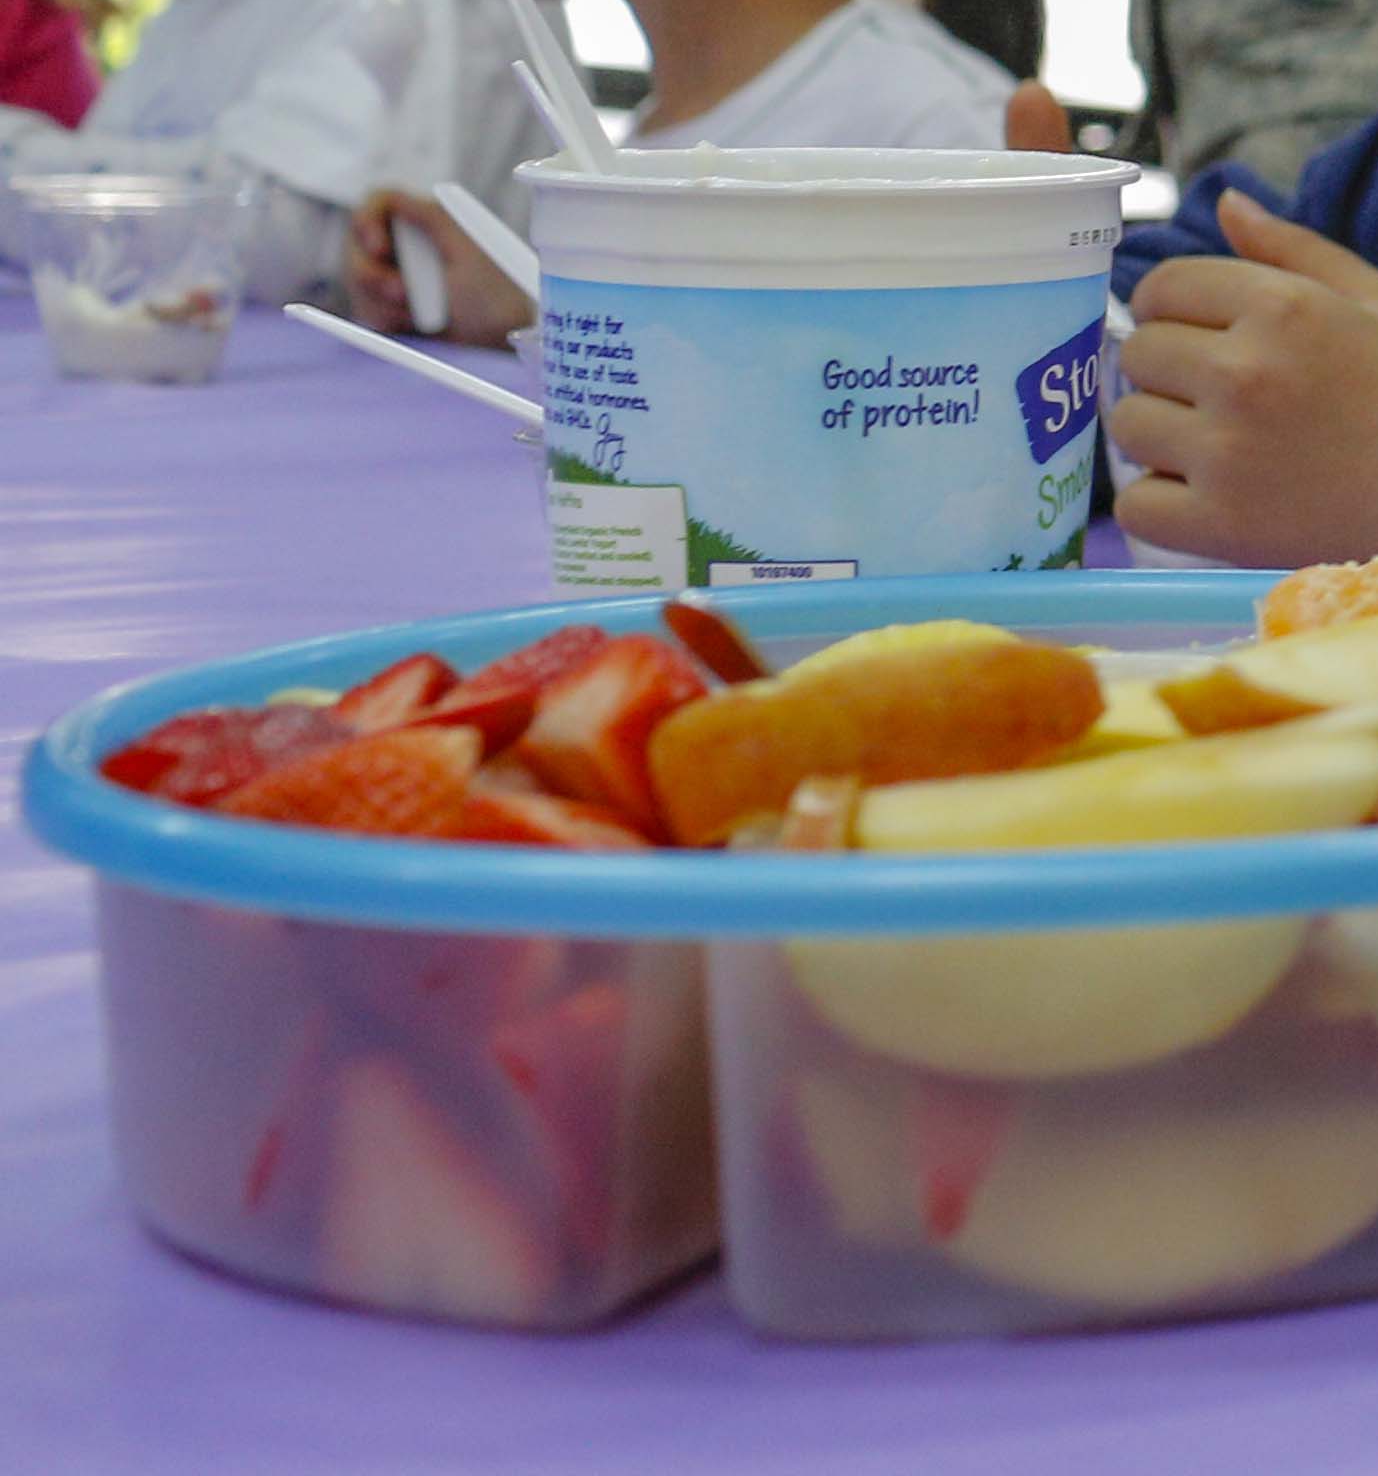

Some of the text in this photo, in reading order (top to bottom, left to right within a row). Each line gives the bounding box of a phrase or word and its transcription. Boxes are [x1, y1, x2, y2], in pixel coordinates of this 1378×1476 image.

[823, 355, 979, 390] Good source
[822, 389, 980, 437] of protein!
